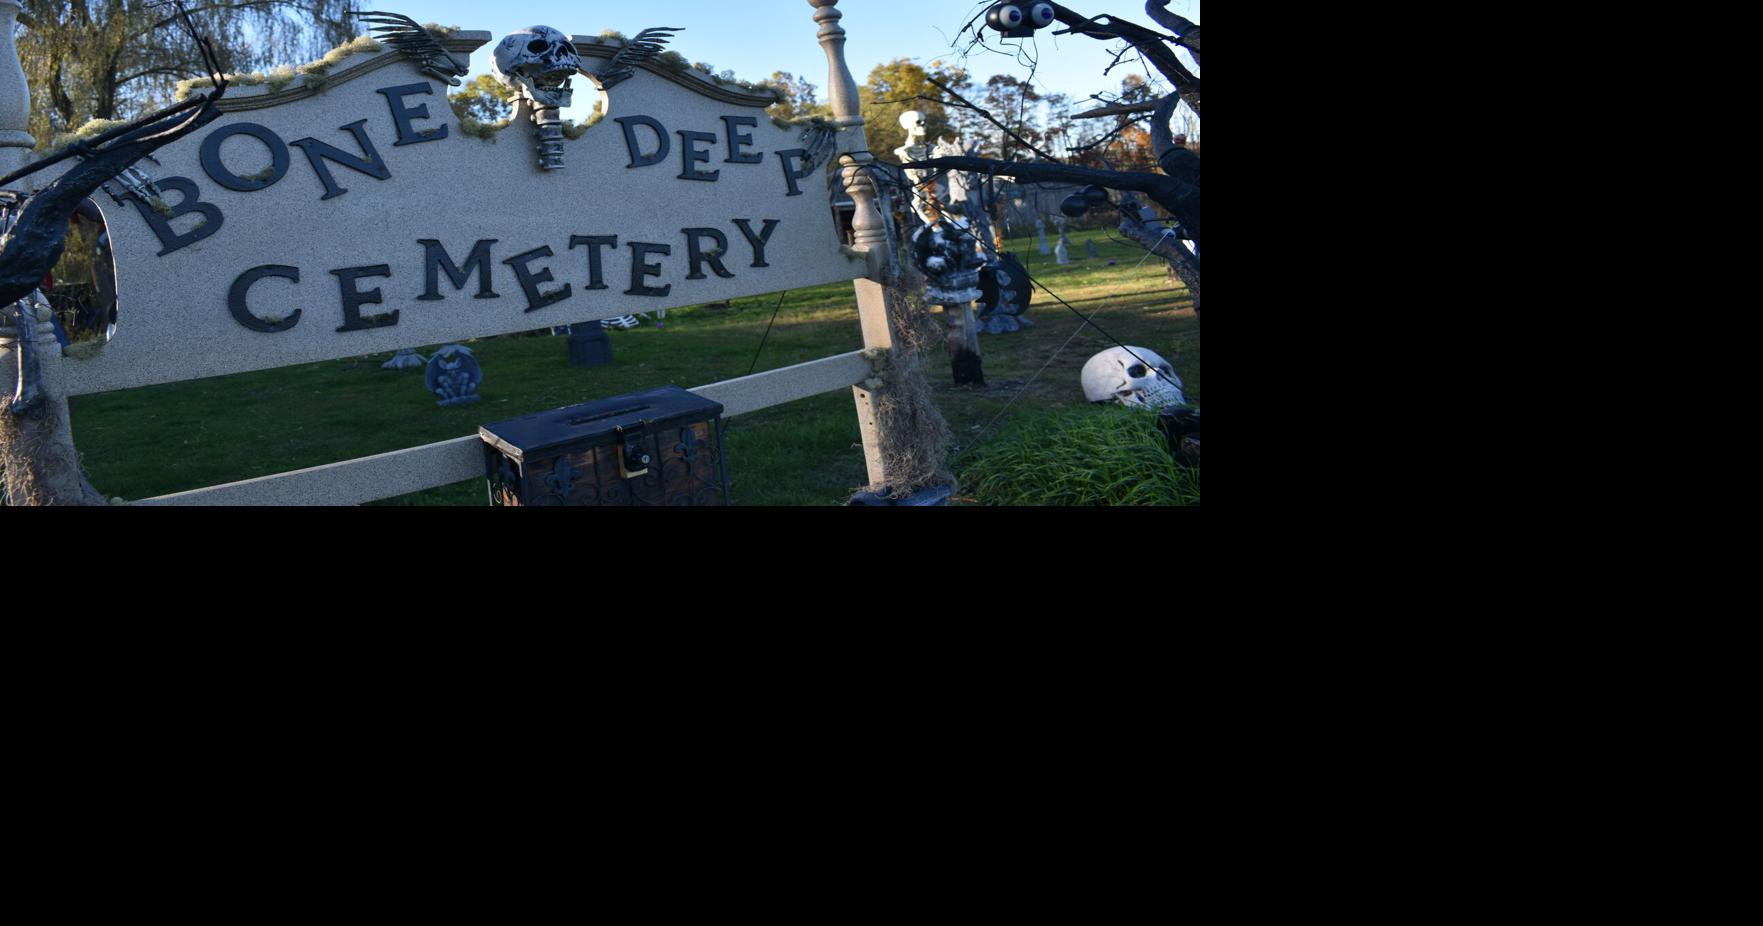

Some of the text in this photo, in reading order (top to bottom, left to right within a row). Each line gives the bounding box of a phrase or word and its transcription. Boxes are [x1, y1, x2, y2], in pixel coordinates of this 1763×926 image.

[120, 82, 815, 257] BONE DEEP
[228, 218, 780, 333] CEMETERY
